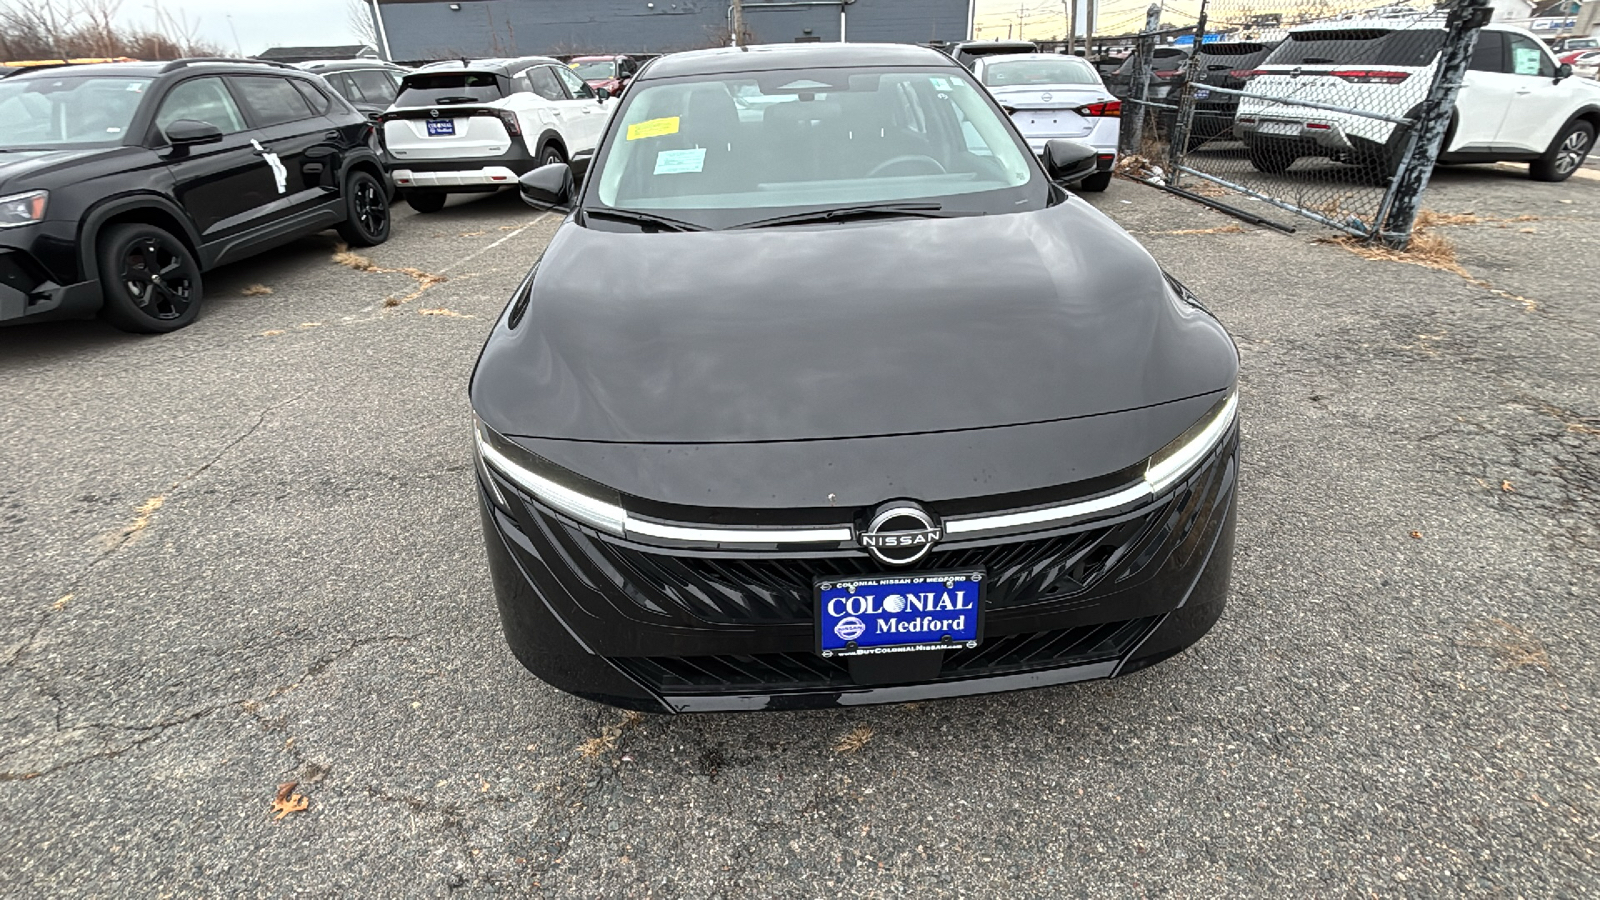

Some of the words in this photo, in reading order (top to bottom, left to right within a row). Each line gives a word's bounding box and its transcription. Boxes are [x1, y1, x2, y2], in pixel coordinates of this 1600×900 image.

[862, 531, 940, 546] NISSAN
[836, 579, 879, 589] COLONIAL
[879, 578, 911, 586] NISSAN
[926, 575, 966, 583] MEDFORD
[827, 591, 973, 617] COLONIAL
[876, 615, 966, 634] Medford
